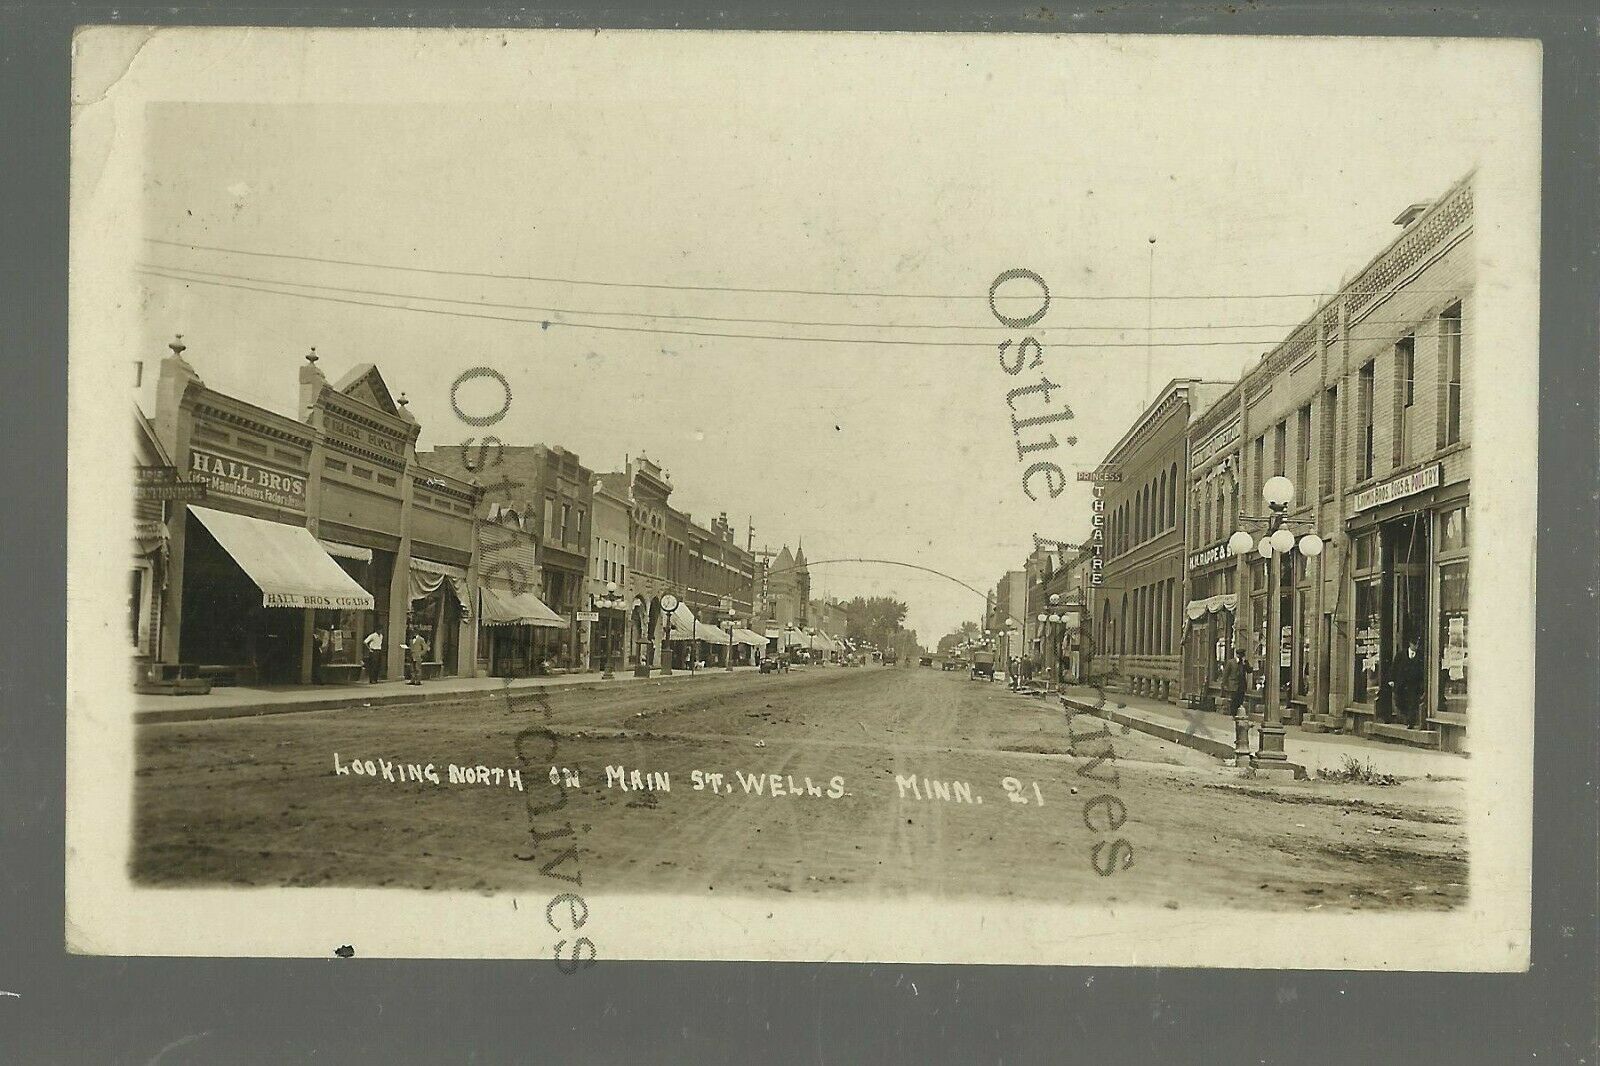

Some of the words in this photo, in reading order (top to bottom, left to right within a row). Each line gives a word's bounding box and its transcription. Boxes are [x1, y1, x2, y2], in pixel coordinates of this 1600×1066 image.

[192, 453, 254, 483] HALL
[1078, 472, 1121, 482] PRINCESS
[1091, 486, 1104, 584] THEATRE
[267, 593, 298, 604] HALL
[336, 597, 370, 606] CIGARS
